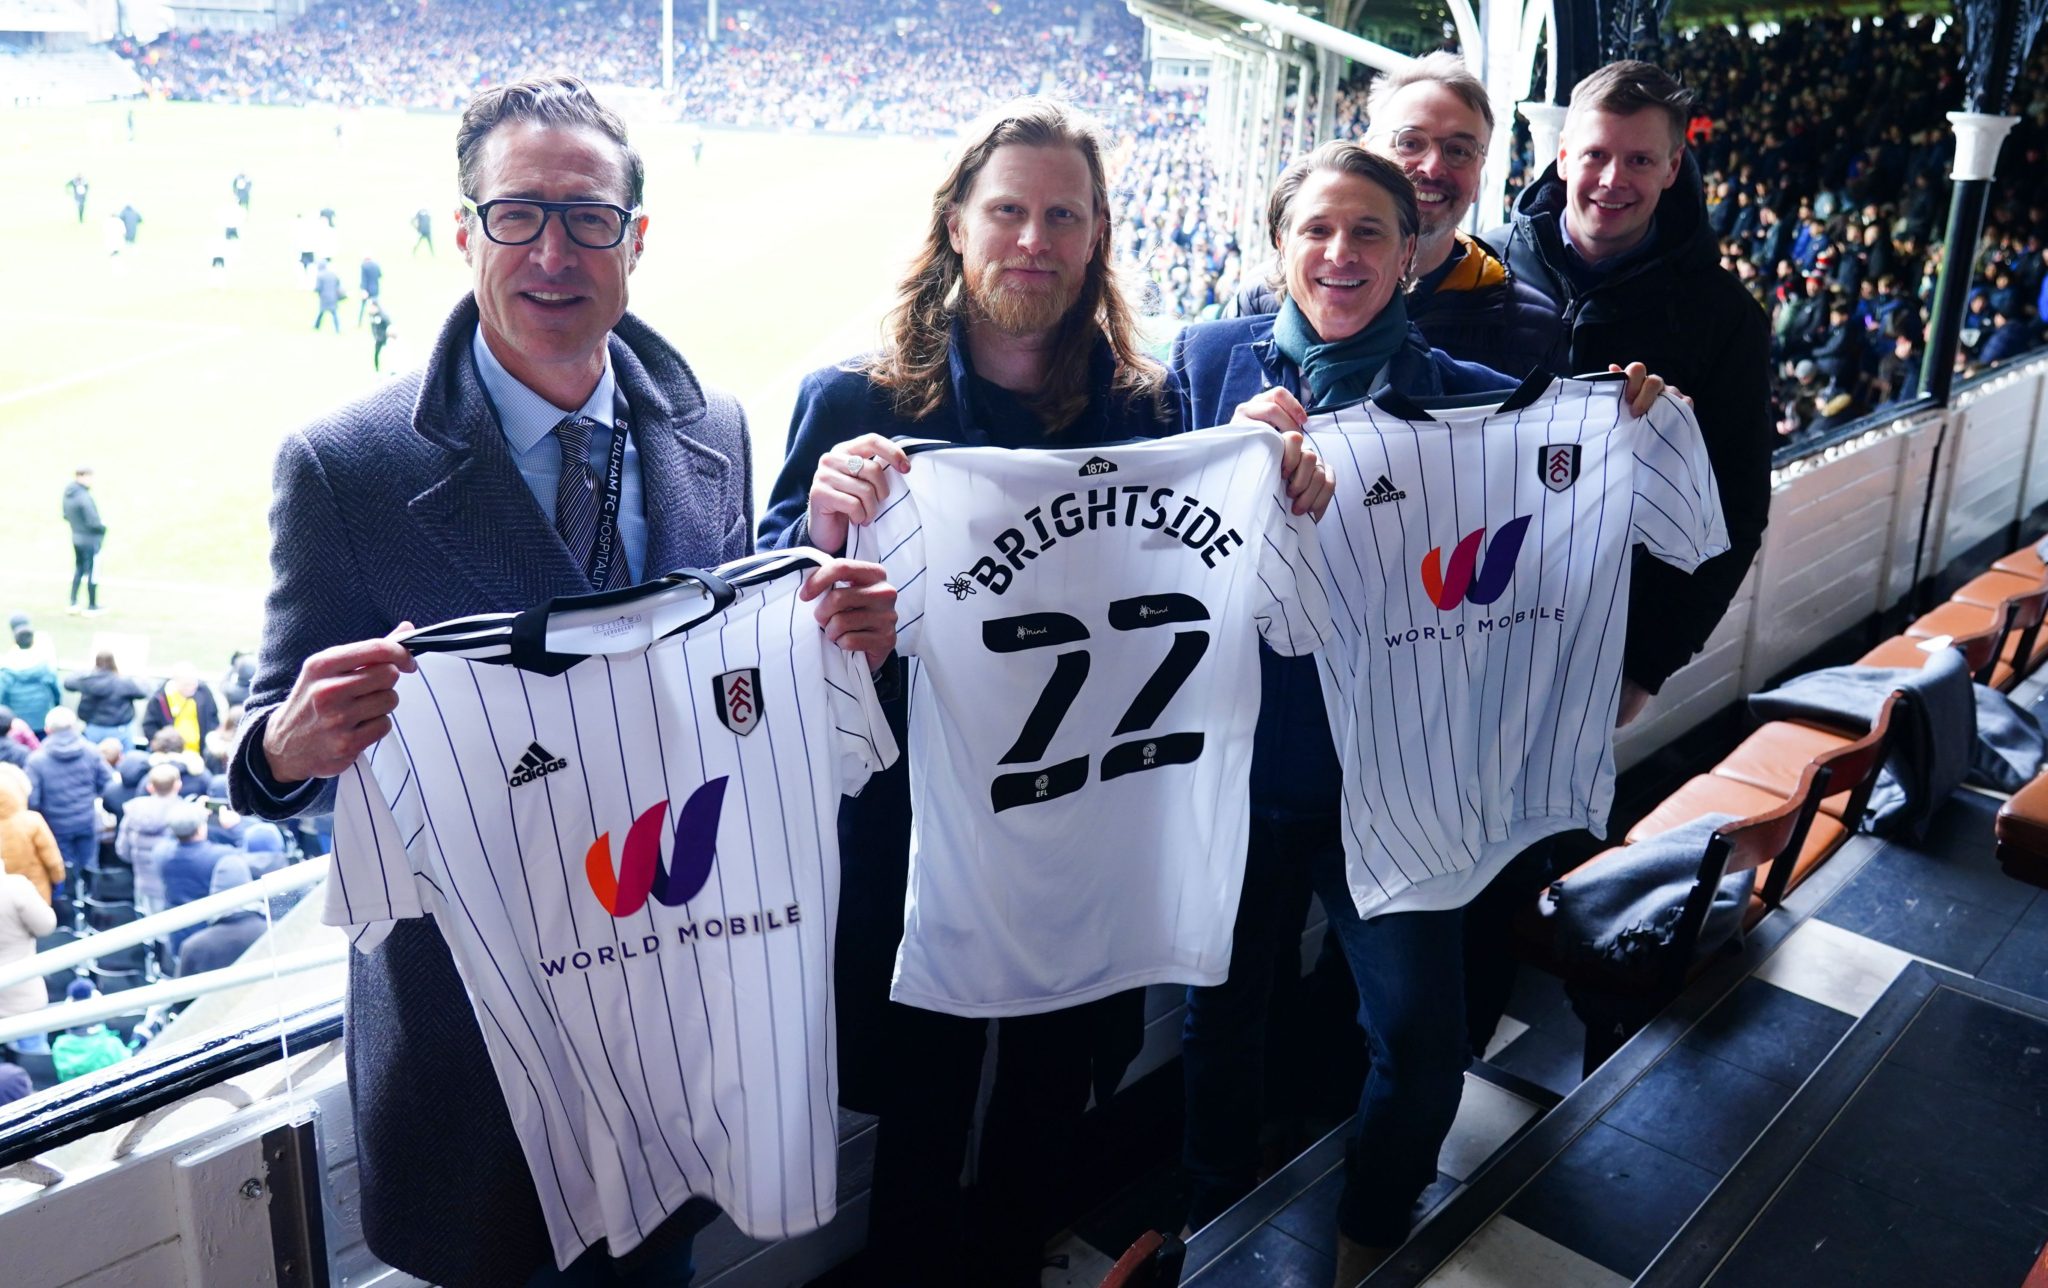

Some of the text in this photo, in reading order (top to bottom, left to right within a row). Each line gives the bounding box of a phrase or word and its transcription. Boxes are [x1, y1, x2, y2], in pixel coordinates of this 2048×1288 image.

[607, 433, 624, 490] FULHAM
[1086, 461, 1110, 475] 1879
[604, 493, 617, 512] FC
[1363, 488, 1406, 507] adidas
[968, 485, 1244, 596] BRIGHTSIDE
[1384, 607, 1565, 648] WORLD MOBILE
[982, 592, 1211, 814] 22
[509, 756, 568, 788] adidas
[1143, 757, 1155, 765] EFL
[1036, 789, 1048, 798] EFL
[540, 904, 801, 977] WORLD MOBILE
